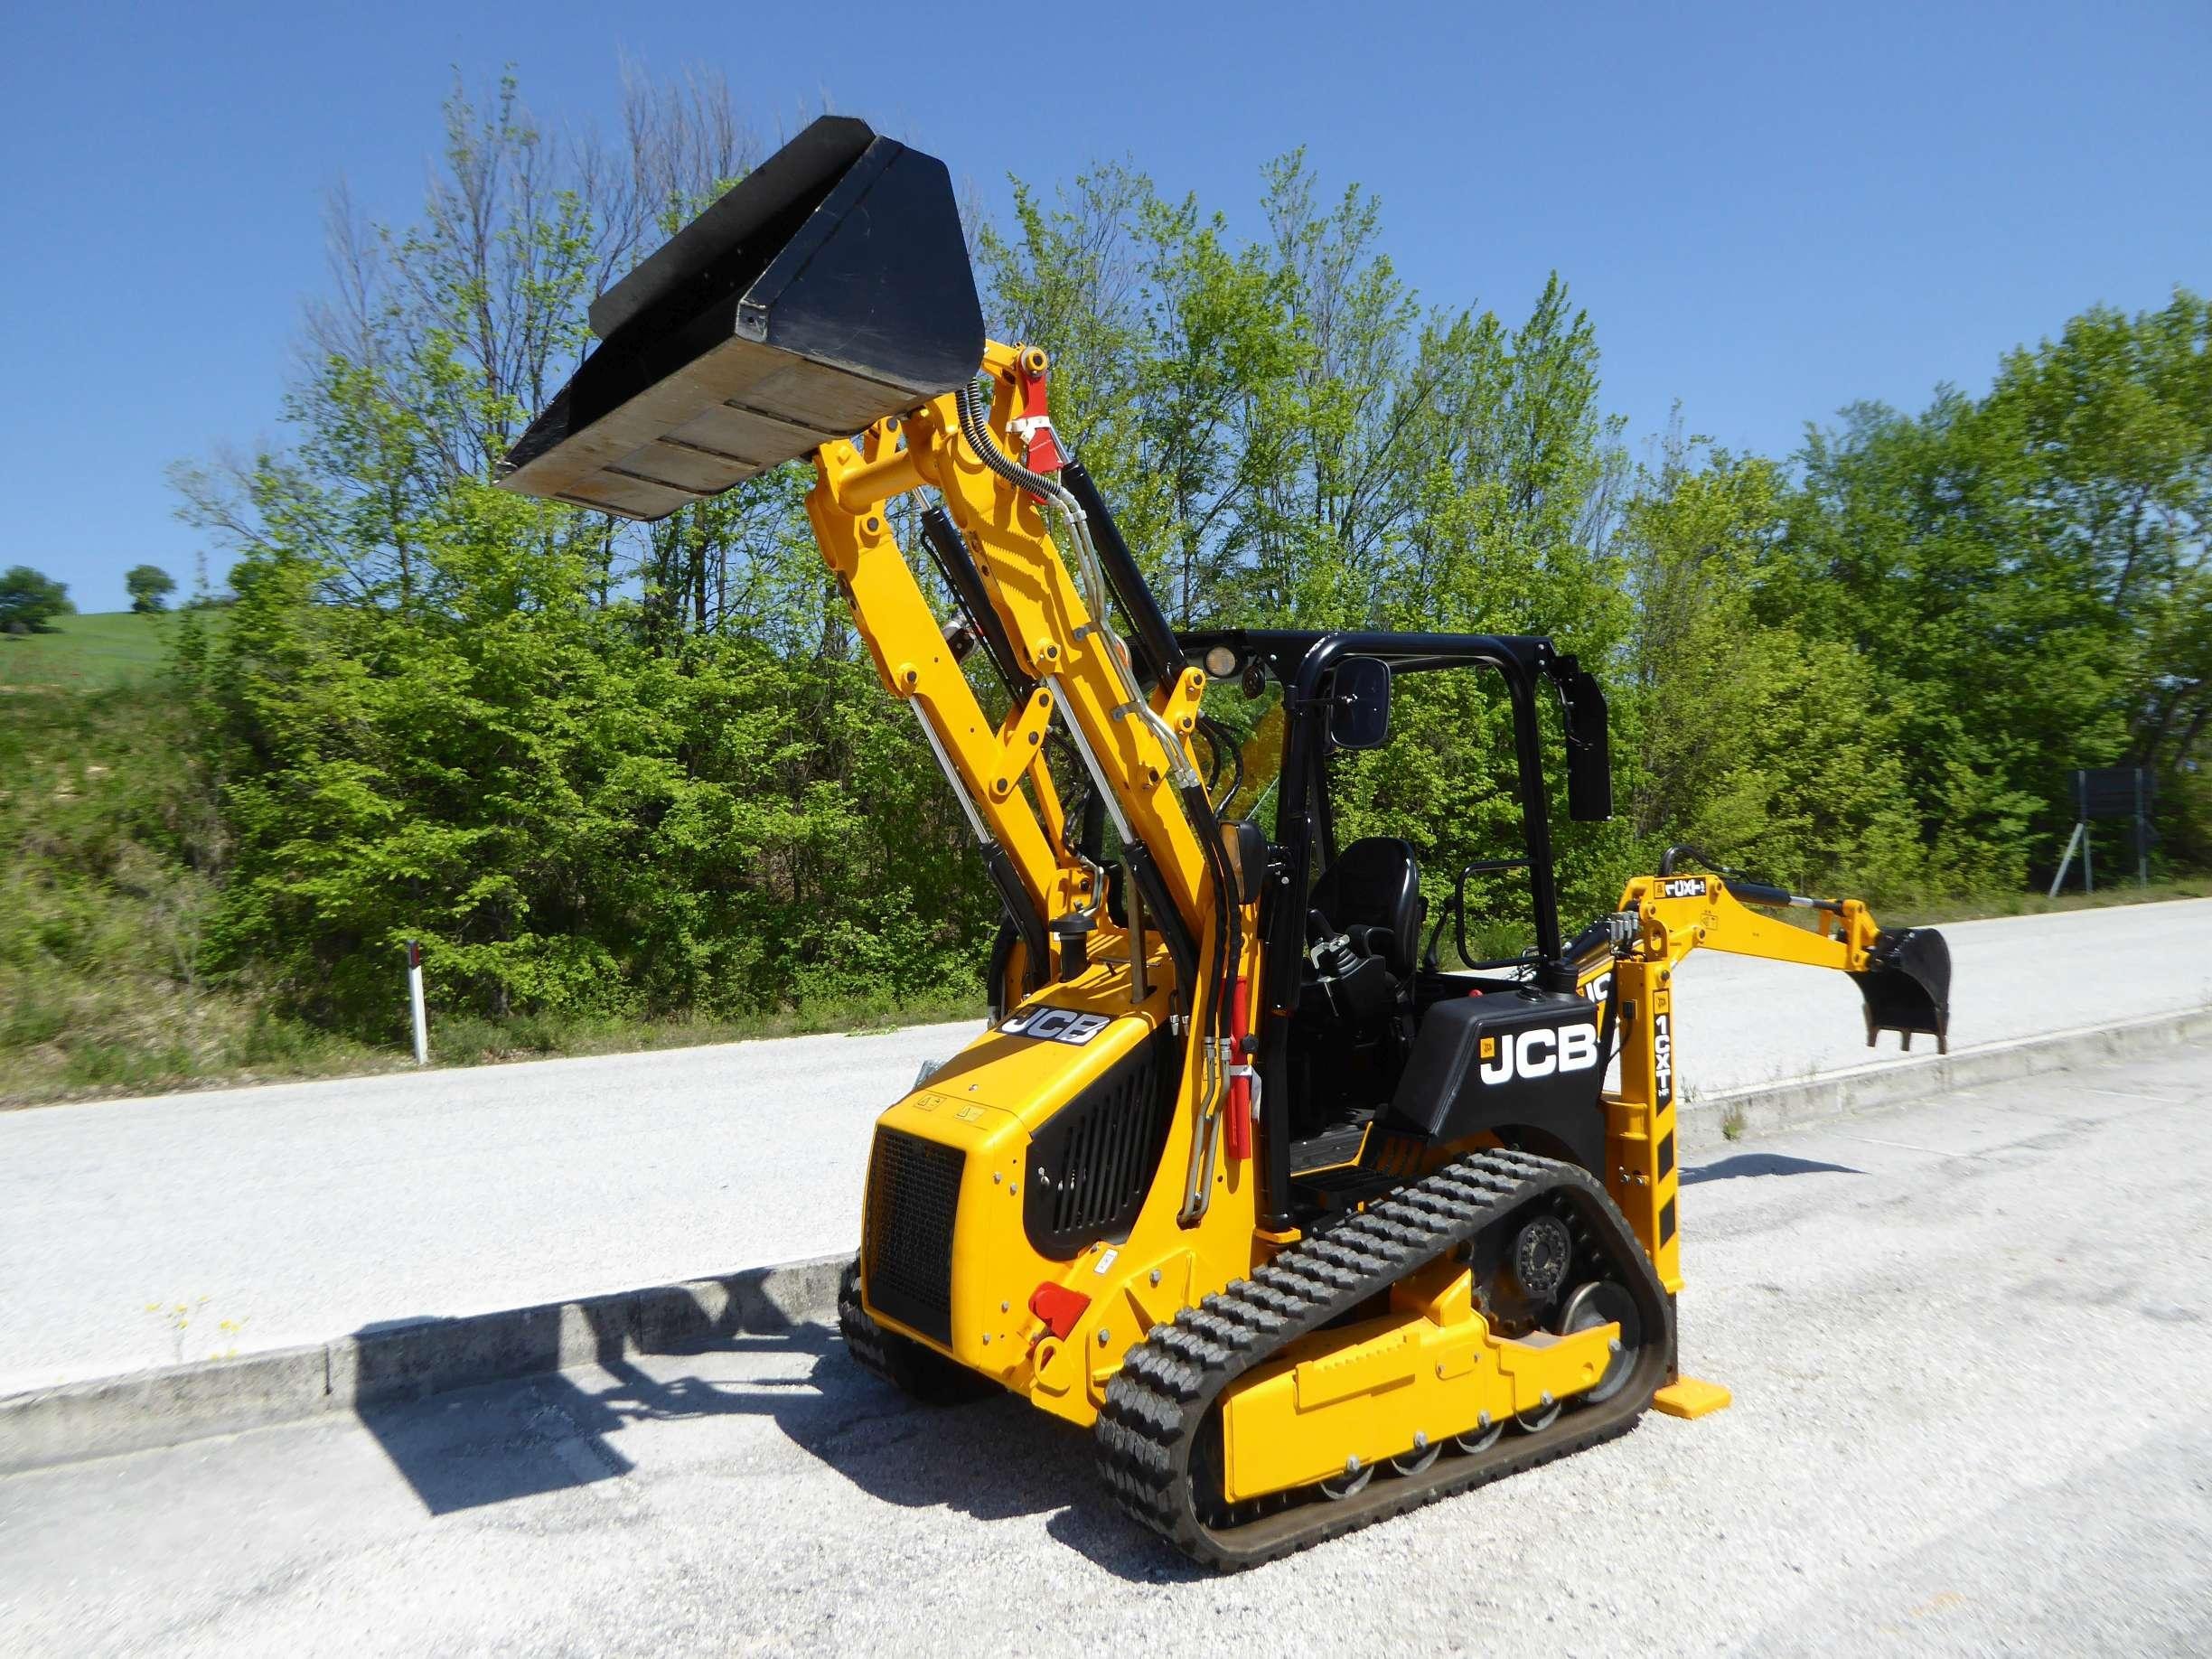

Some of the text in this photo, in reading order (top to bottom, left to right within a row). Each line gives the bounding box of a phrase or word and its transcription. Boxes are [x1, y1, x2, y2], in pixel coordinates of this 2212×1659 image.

[1002, 1008, 1110, 1044] JCB
[1480, 1023, 1598, 1084] JCB
[1654, 1015, 1671, 1088] 1CXT
